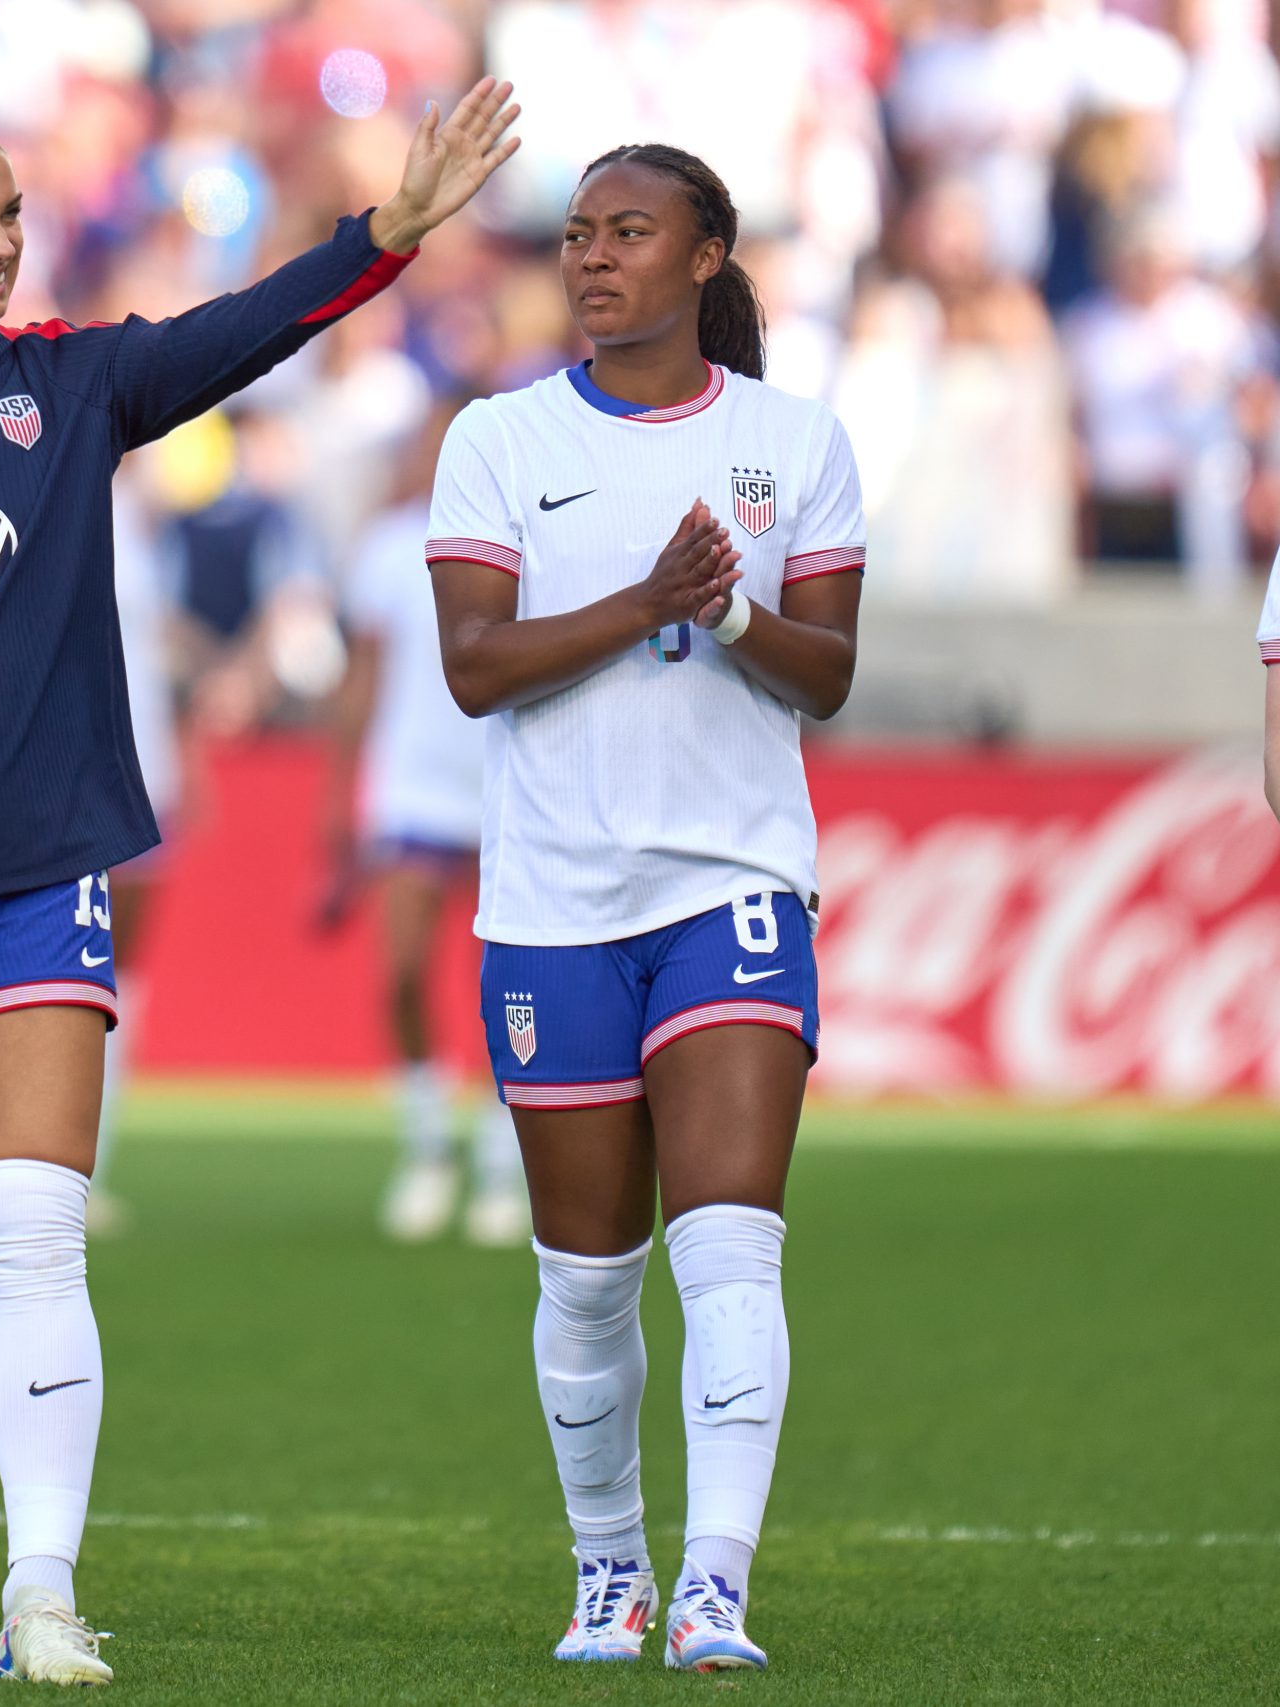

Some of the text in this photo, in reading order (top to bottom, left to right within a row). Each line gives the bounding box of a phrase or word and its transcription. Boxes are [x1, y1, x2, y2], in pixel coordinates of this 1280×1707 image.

[735, 480, 772, 504] USA
[74, 868, 111, 931] 13
[731, 891, 780, 954] 8
[507, 1007, 533, 1032] USA
